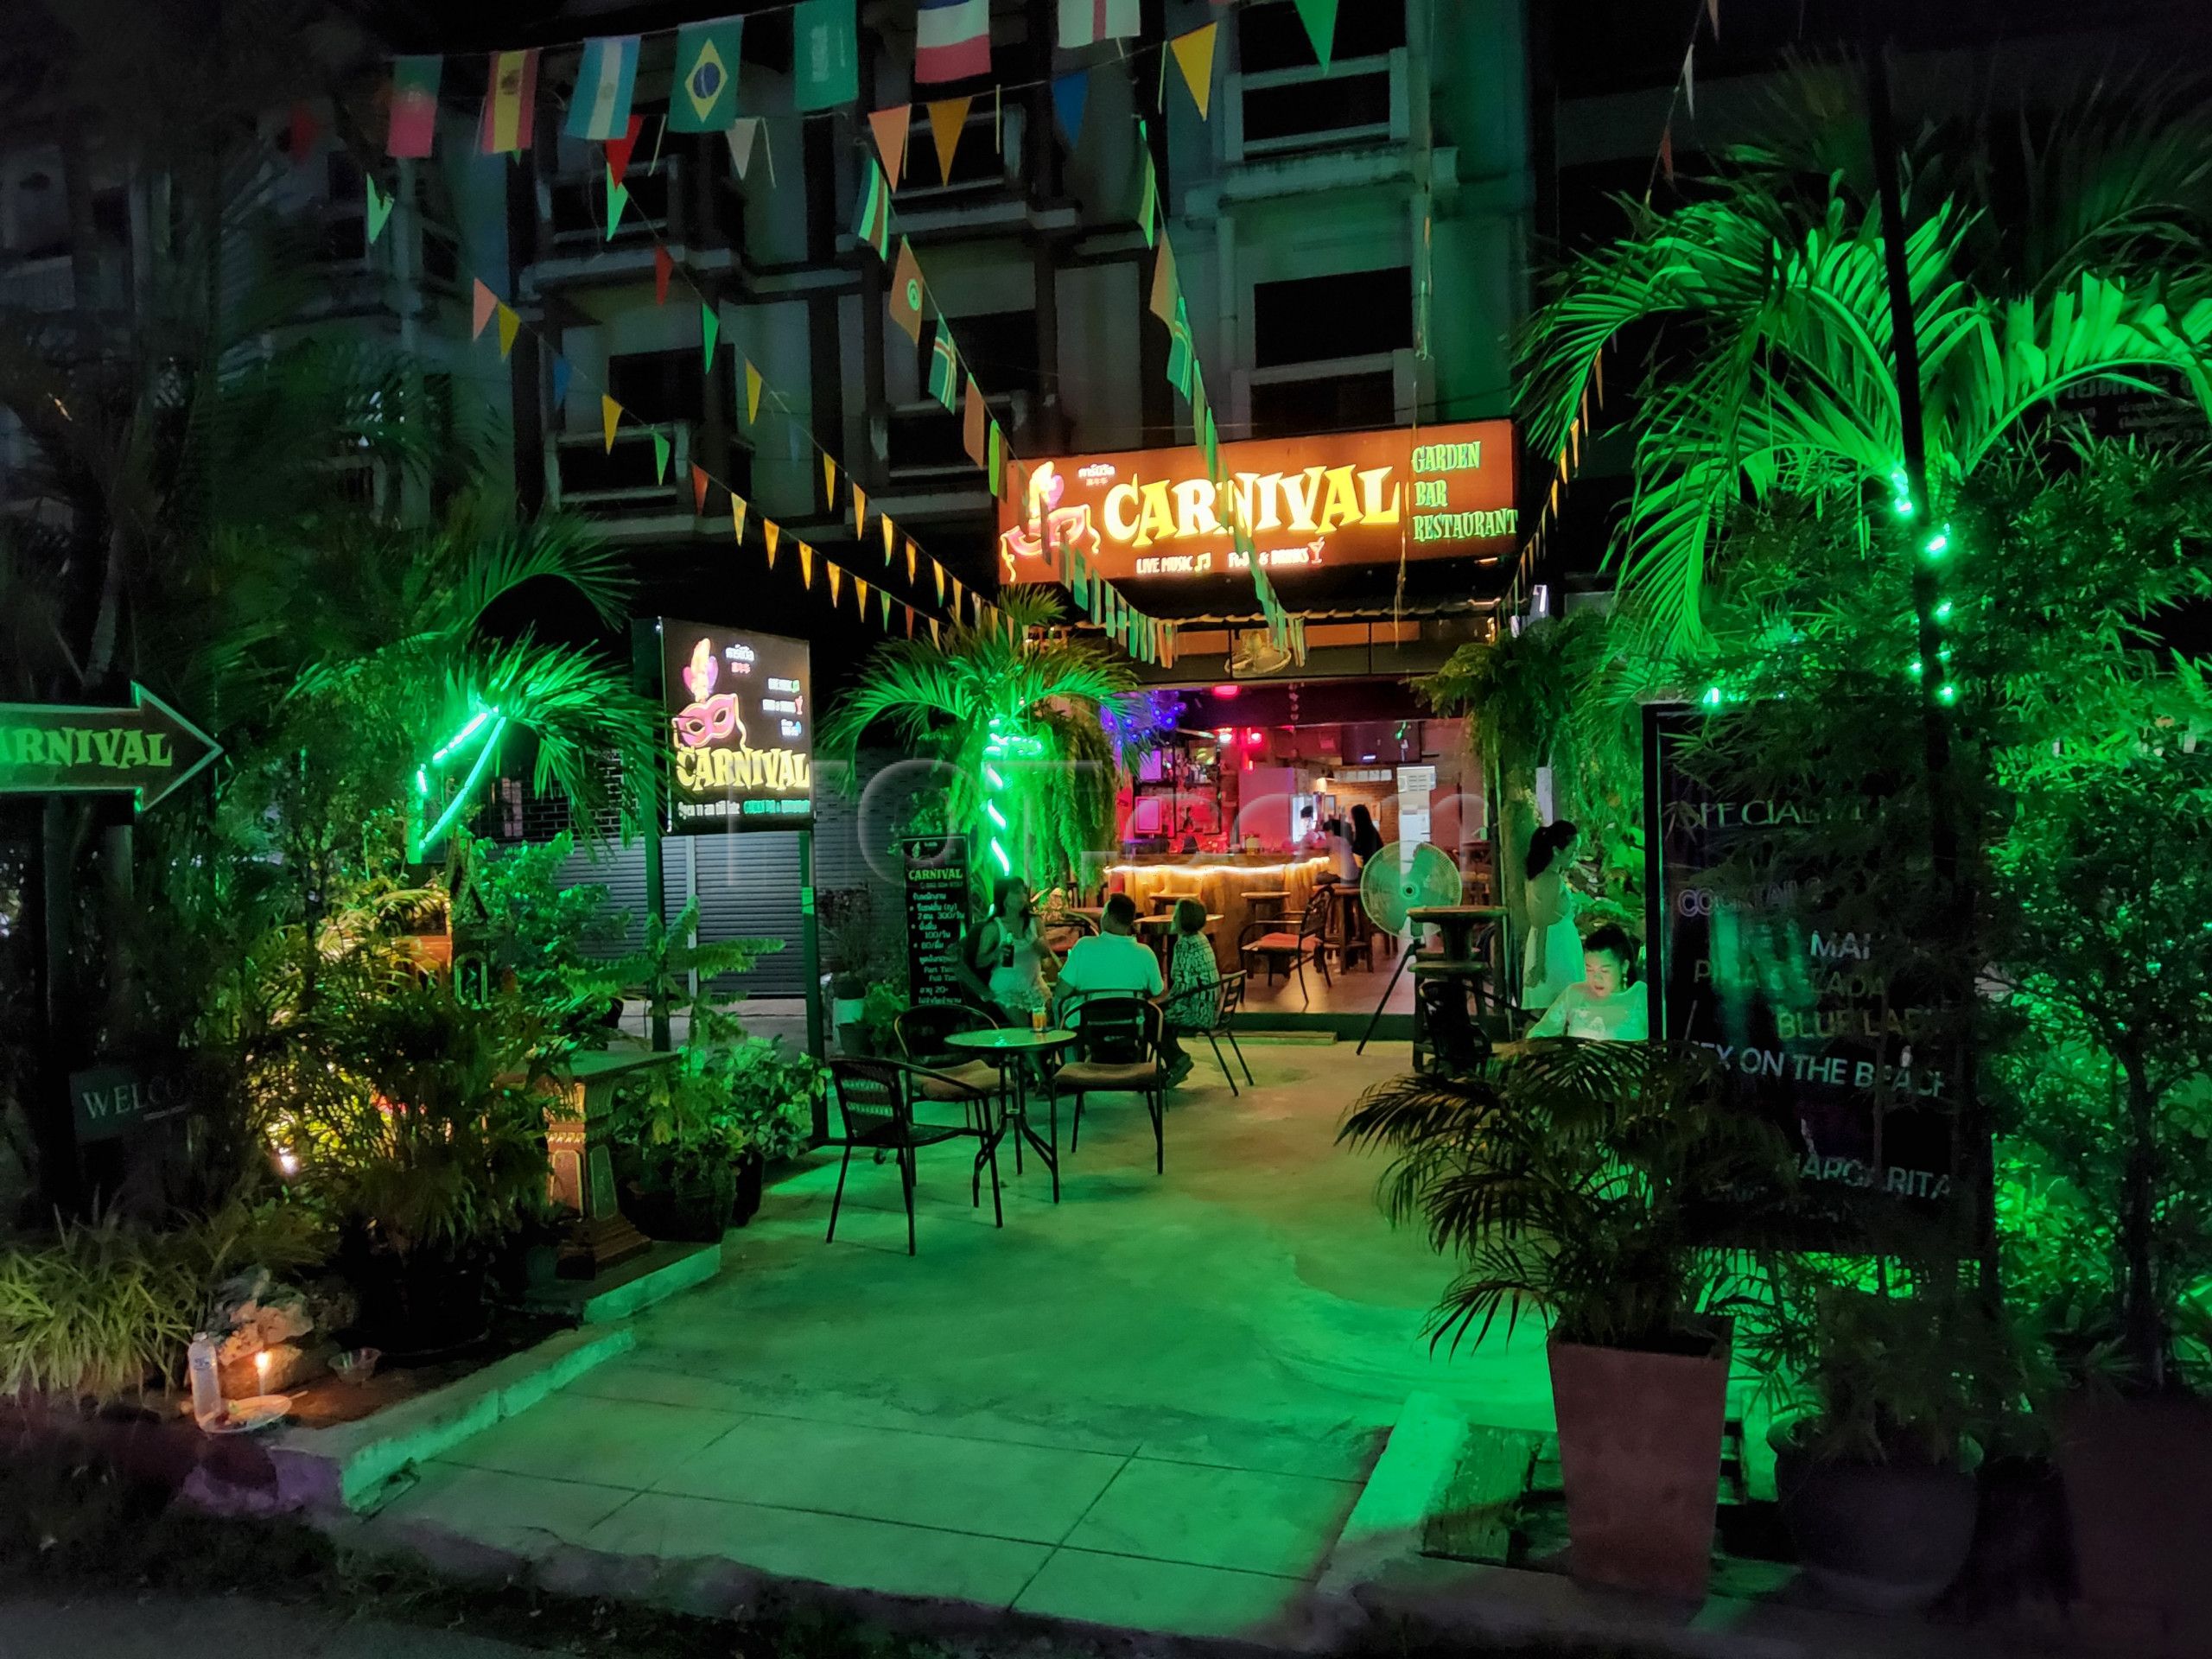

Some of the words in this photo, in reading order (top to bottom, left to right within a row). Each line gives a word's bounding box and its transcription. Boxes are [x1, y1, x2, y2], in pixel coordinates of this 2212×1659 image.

[1412, 442, 1480, 473] GARDEN
[1104, 464, 1401, 547] CARNIVAL
[1414, 480, 1448, 507] BAR
[1413, 508, 1518, 542] RESTAURANT
[1136, 557, 1160, 574] LIVE
[1161, 556, 1193, 572] MUSIC
[0, 727, 172, 769] RNIVAL
[677, 747, 810, 791] CARNIVAL
[908, 868, 963, 881] CARNIVAL
[1739, 1047, 1785, 1077] ON
[1792, 1052, 1848, 1084] THE
[1854, 1060, 1945, 1097] BACH
[81, 1074, 183, 1120] WELCO
[1787, 1153, 1952, 1200] ARGRITA
